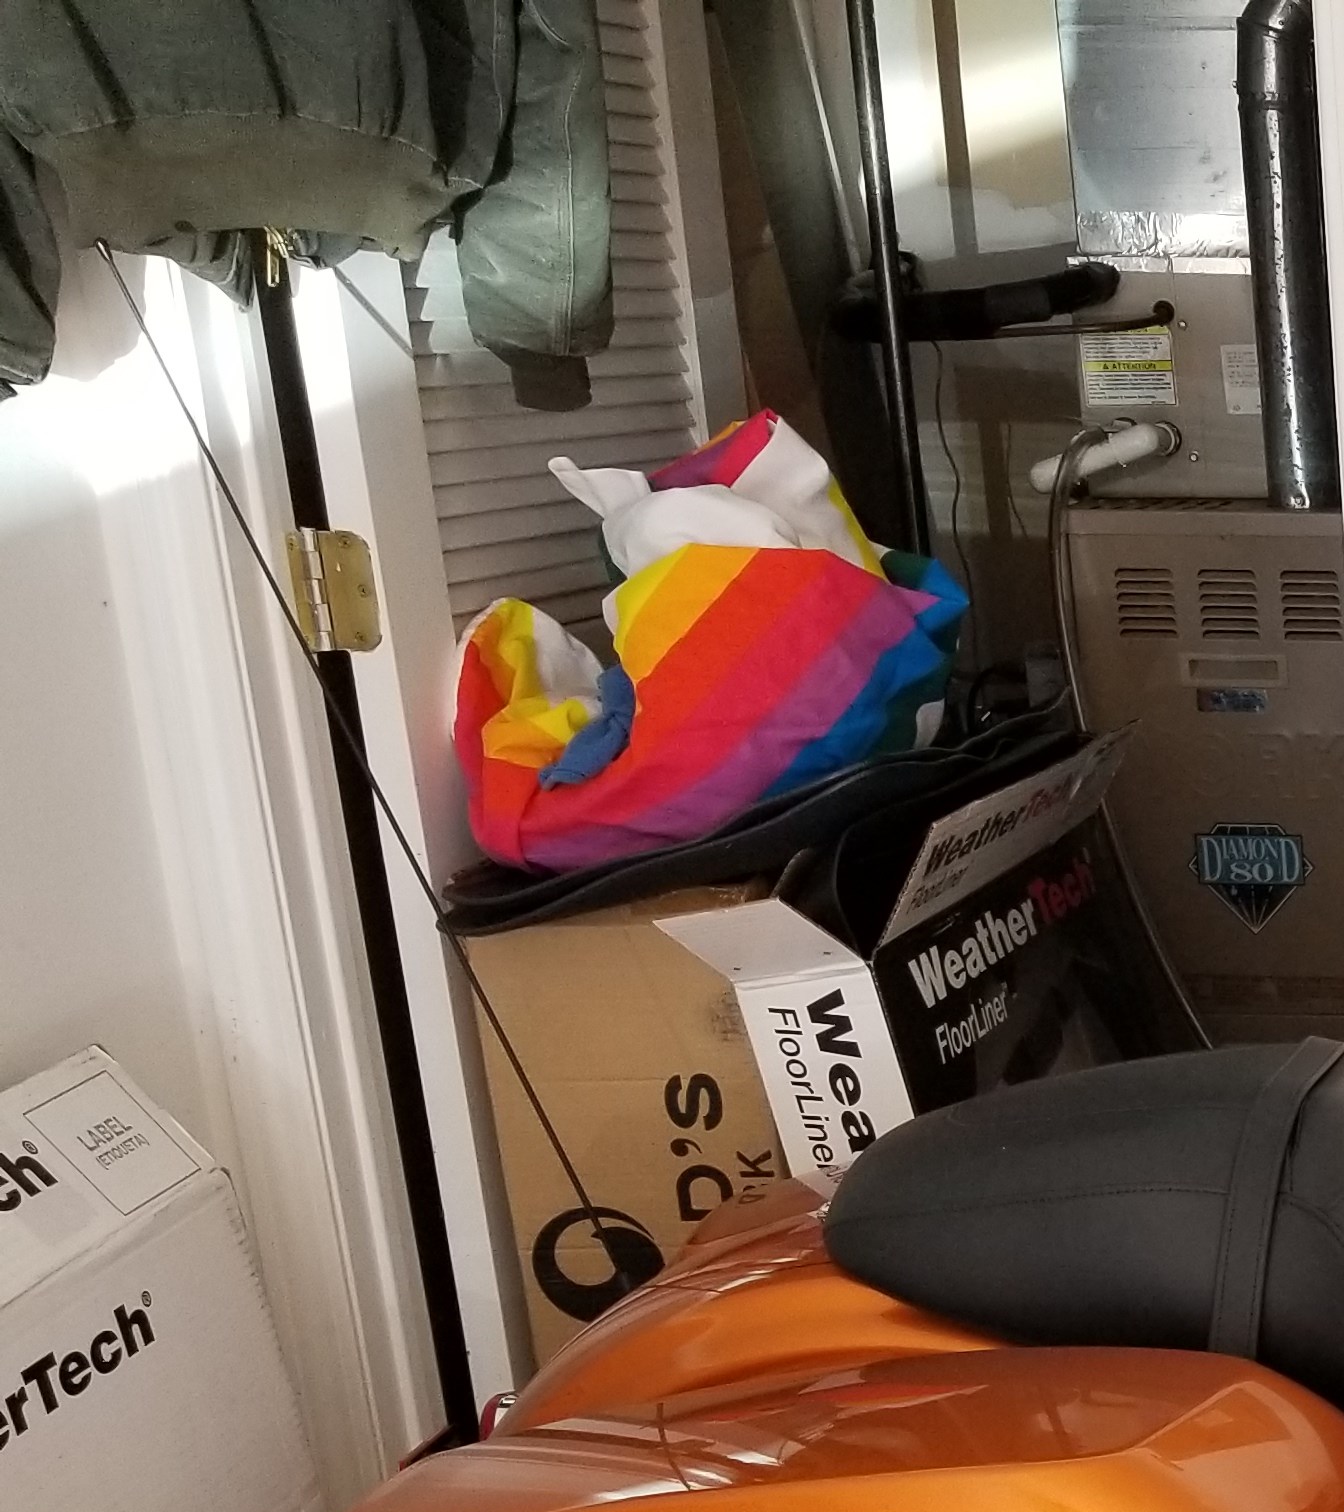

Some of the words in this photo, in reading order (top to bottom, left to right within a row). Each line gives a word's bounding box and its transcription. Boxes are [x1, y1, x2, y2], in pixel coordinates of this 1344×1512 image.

[1201, 836, 1300, 882] DIAMOND
[1230, 861, 1274, 883] 80
[935, 990, 1008, 1064] FloorLiner
[76, 1116, 133, 1153] LABEL
[95, 1133, 150, 1170] (ETIQUETA)
